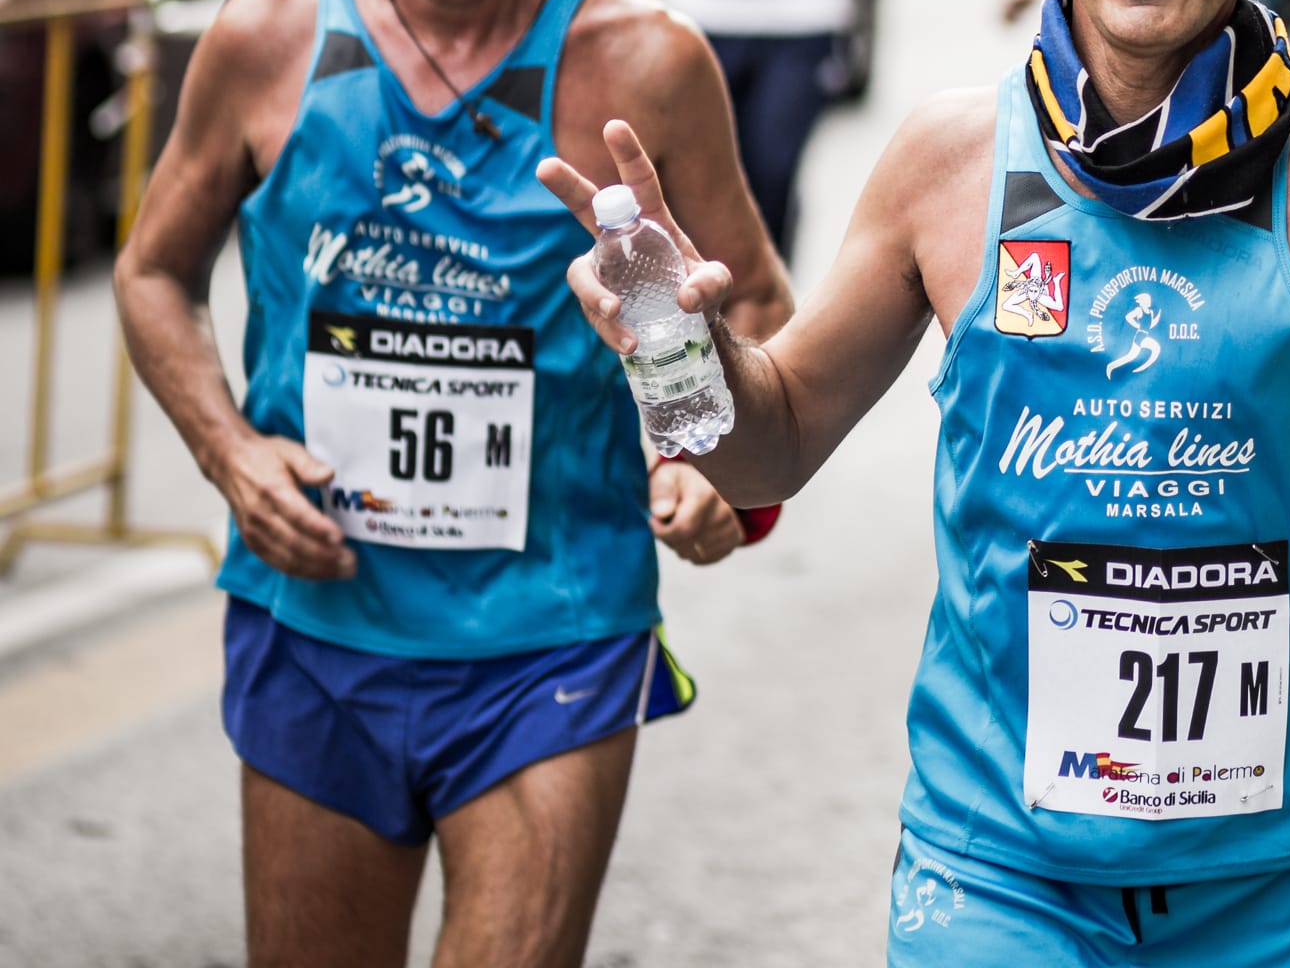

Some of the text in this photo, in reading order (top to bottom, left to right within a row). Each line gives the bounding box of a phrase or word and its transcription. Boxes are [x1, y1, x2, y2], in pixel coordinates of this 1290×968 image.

[355, 221, 489, 261] AUTO SERVIZI
[303, 222, 511, 297] Mothia lines
[361, 284, 482, 316] VIAGGI
[1088, 266, 1157, 319] POLISPORTIVA
[1159, 268, 1205, 311] MARSALA
[370, 330, 525, 362] DIADORA
[1169, 323, 1200, 340] D.O.C.
[350, 370, 519, 397] TECNICA SPORT
[1072, 398, 1232, 419] AUTO SERVIZI
[389, 407, 512, 482] 56 M
[998, 405, 1256, 479] Mothia lines
[1085, 479, 1225, 498] VIAGGI
[1106, 502, 1204, 518] MARSALA
[1105, 559, 1278, 590] DIADORA
[1081, 607, 1277, 636] TECNICA SPORT
[1117, 649, 1219, 743] 217
[1239, 660, 1269, 717] M
[1057, 750, 1265, 785] Maratona di Palermo
[1120, 789, 1216, 807] Banco di Sicilia
